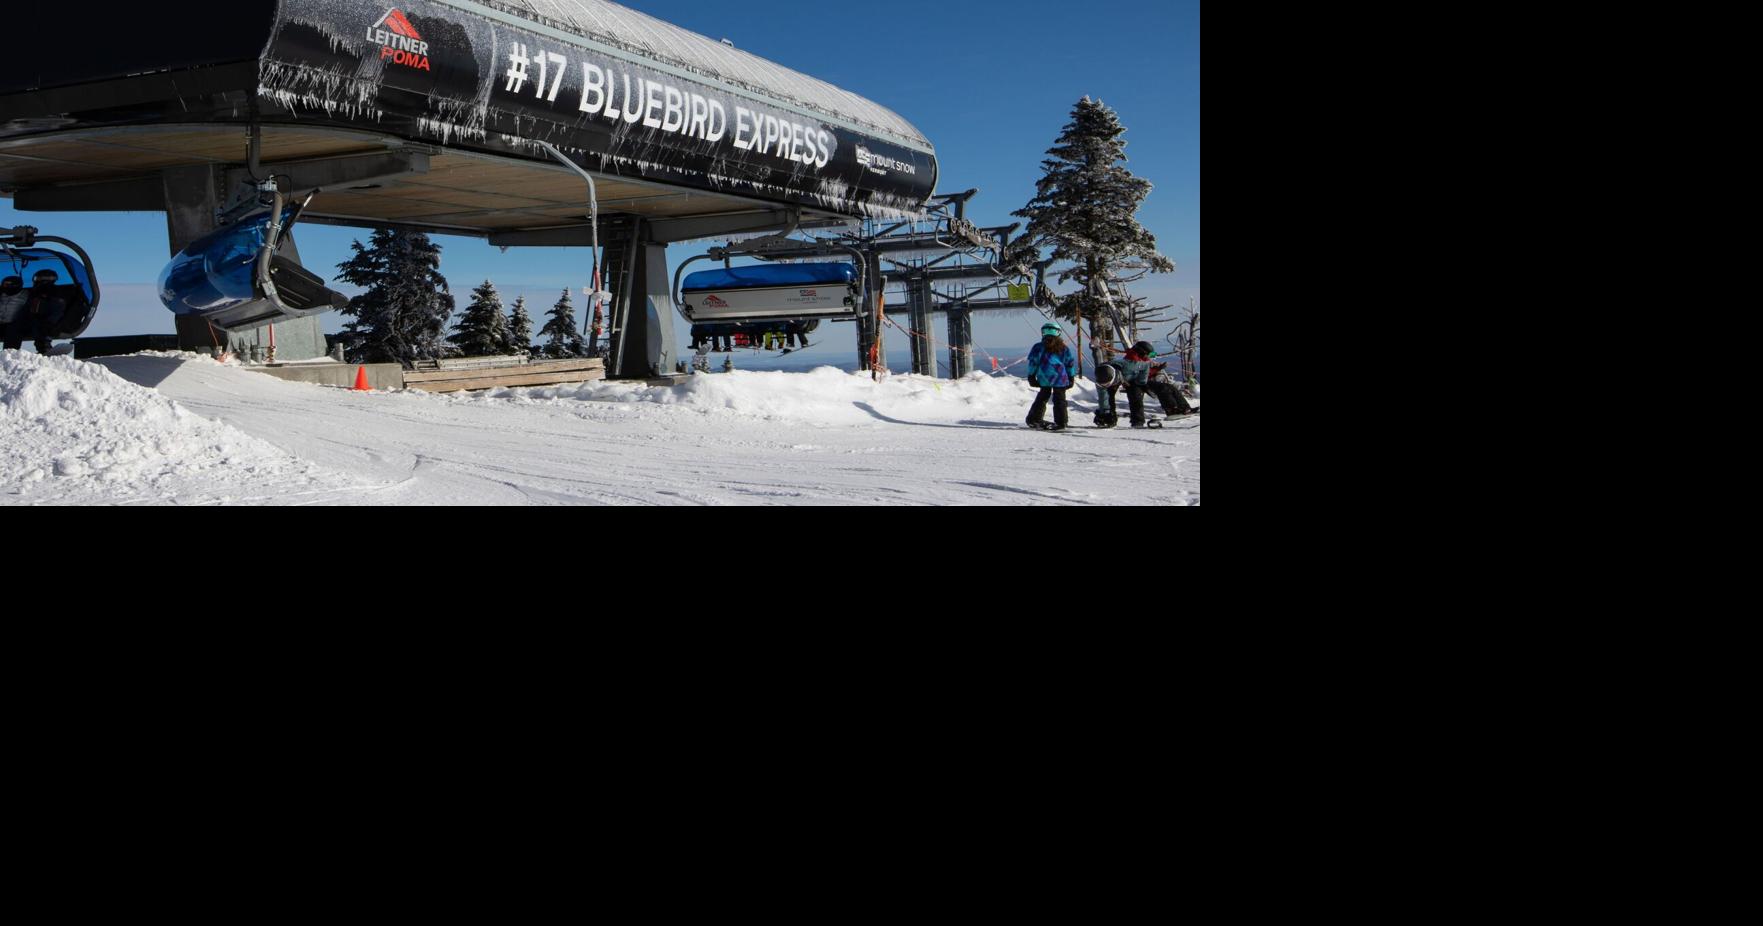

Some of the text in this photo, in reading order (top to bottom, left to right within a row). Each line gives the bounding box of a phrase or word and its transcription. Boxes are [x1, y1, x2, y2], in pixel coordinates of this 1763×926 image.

[366, 26, 429, 56] LEITNER
[380, 45, 430, 71] POMA
[506, 42, 828, 168] #17 BLUEBIRD EXPRESS
[870, 153, 896, 170] mount
[896, 161, 915, 175] snow
